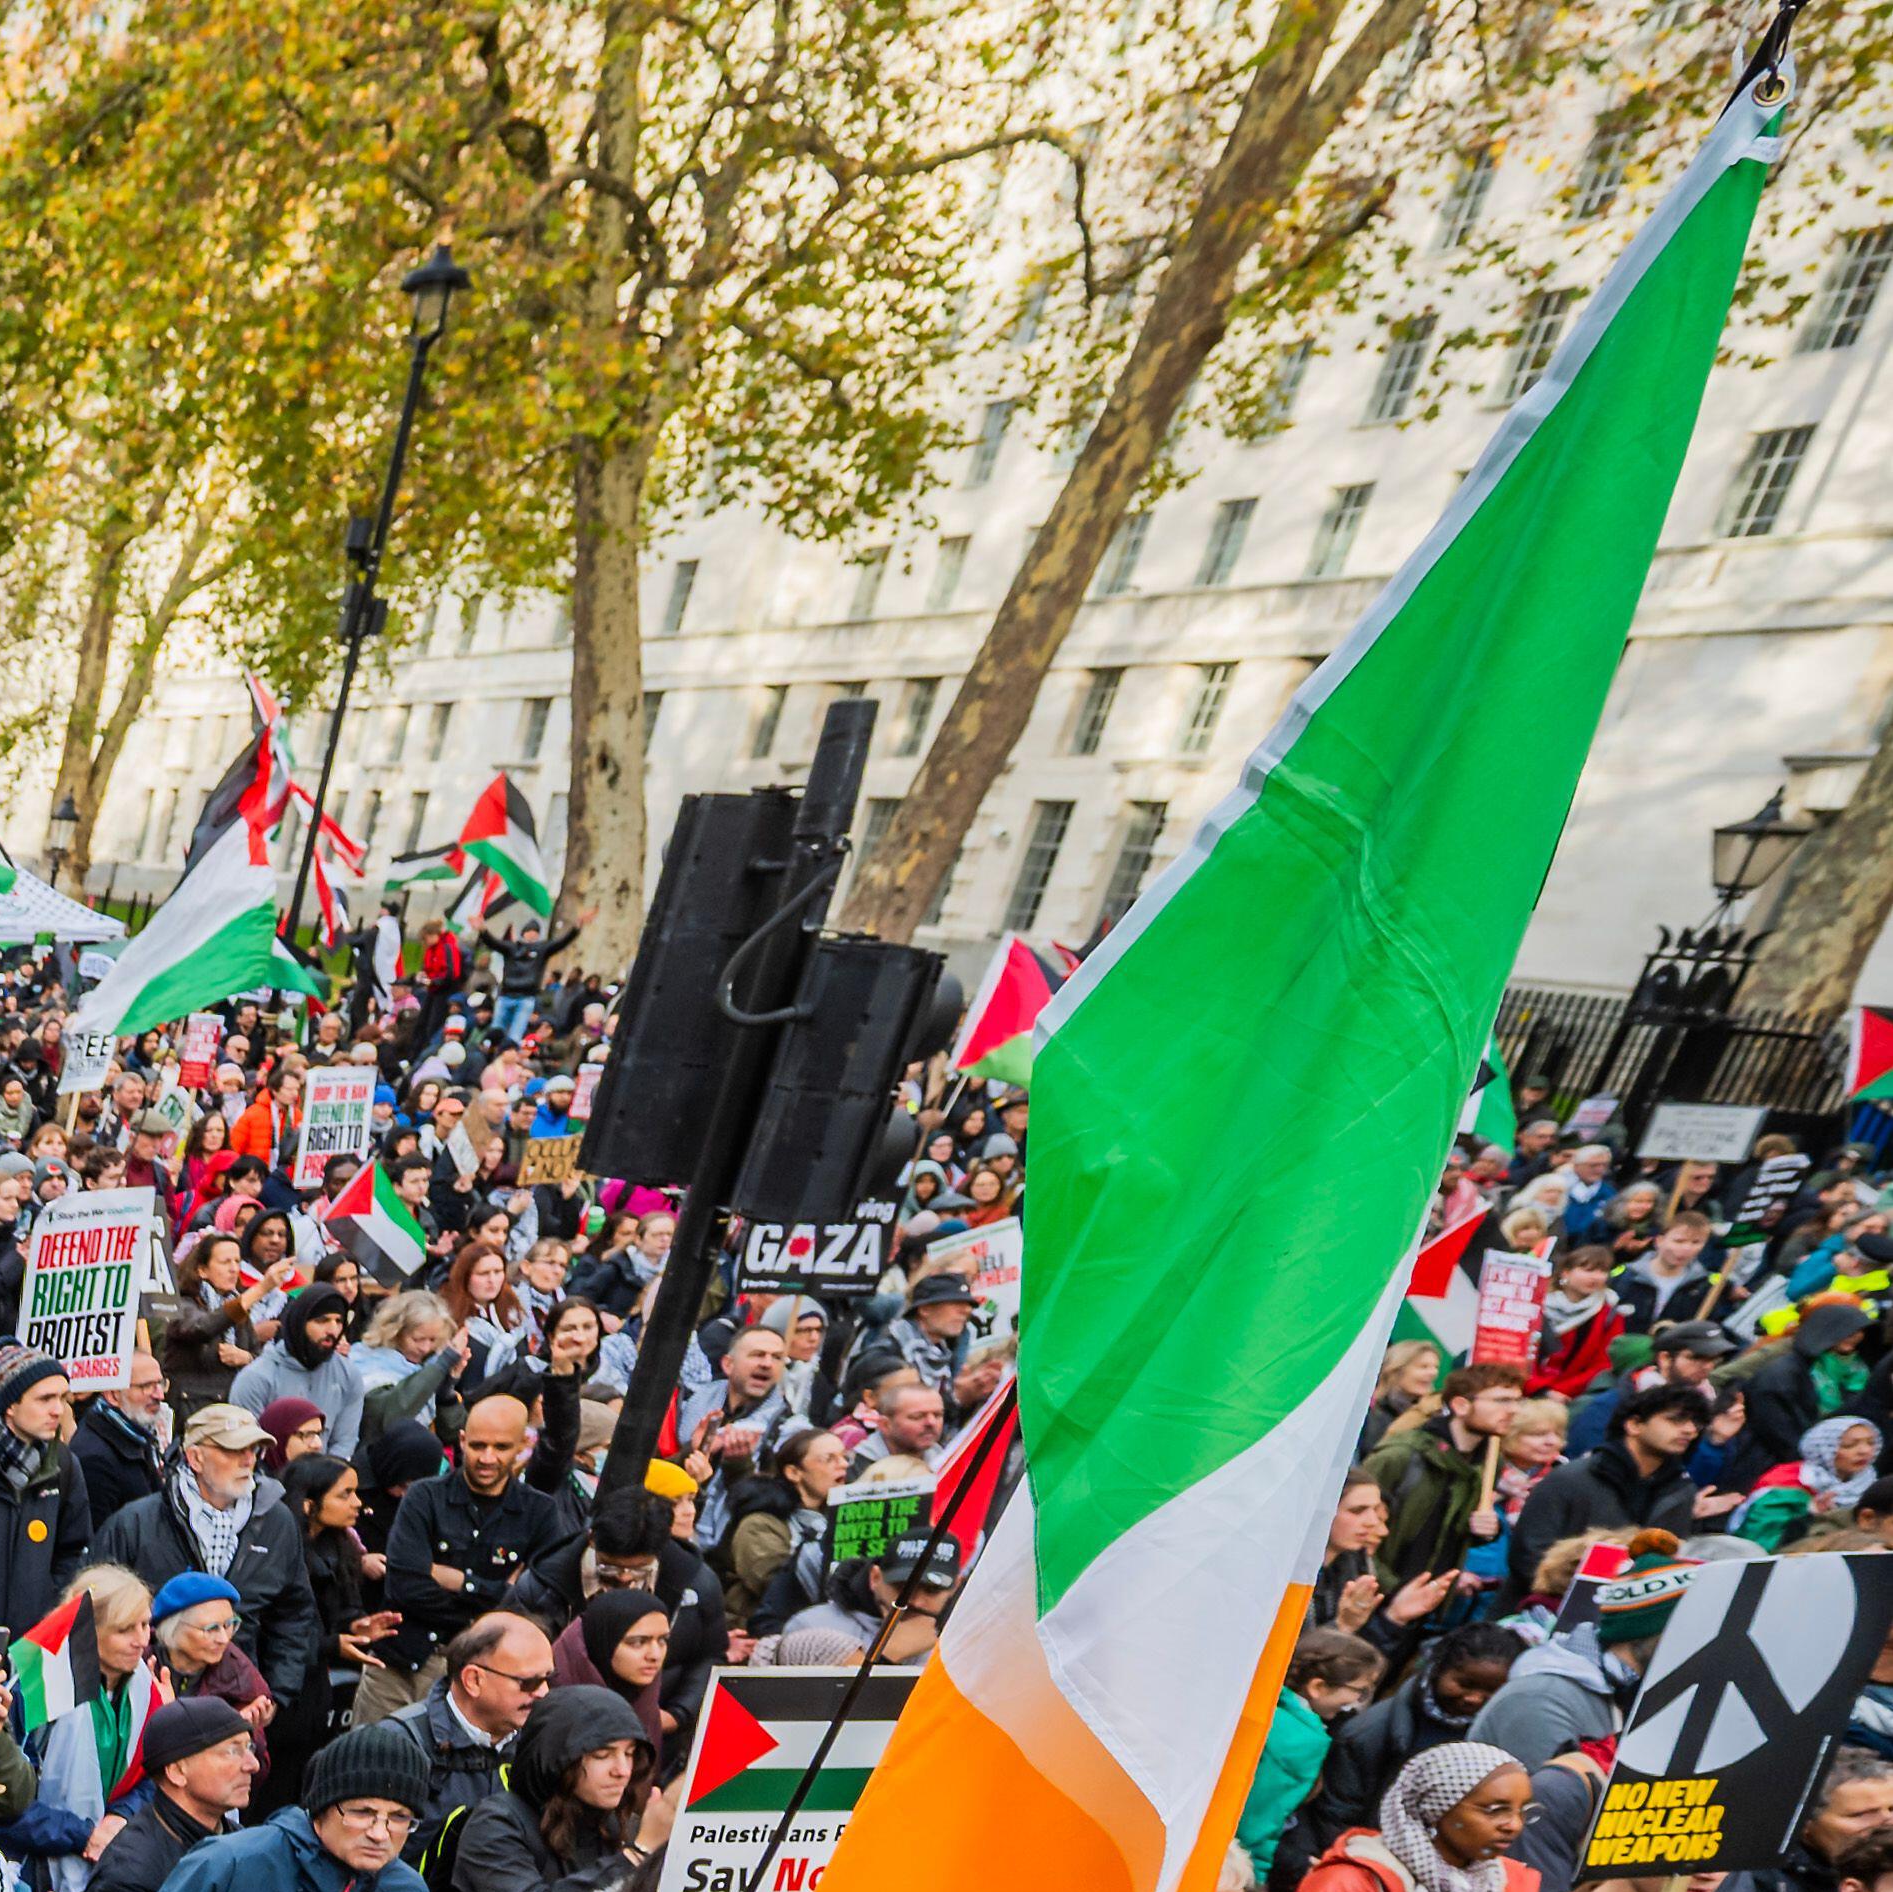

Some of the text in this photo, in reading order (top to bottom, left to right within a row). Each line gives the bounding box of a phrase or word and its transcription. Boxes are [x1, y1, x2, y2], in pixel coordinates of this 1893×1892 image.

[306, 1124, 364, 1151] RIGHT TO
[37, 1225, 140, 1270] DEFEND THE
[745, 1222, 883, 1275] GAZA
[30, 1263, 132, 1318] RIGHT TO
[26, 1311, 125, 1360] PROTEST
[70, 1357, 121, 1380] CHARGES
[836, 1495, 922, 1524] FROM THE
[833, 1517, 909, 1542] RIVER TO
[833, 1540, 863, 1561] THE
[1610, 1778, 1719, 1811] NO NEW
[690, 1824, 828, 1843] Palestians
[1594, 1804, 1726, 1838] NUCLEAR
[1586, 1832, 1723, 1867] WEAPONS
